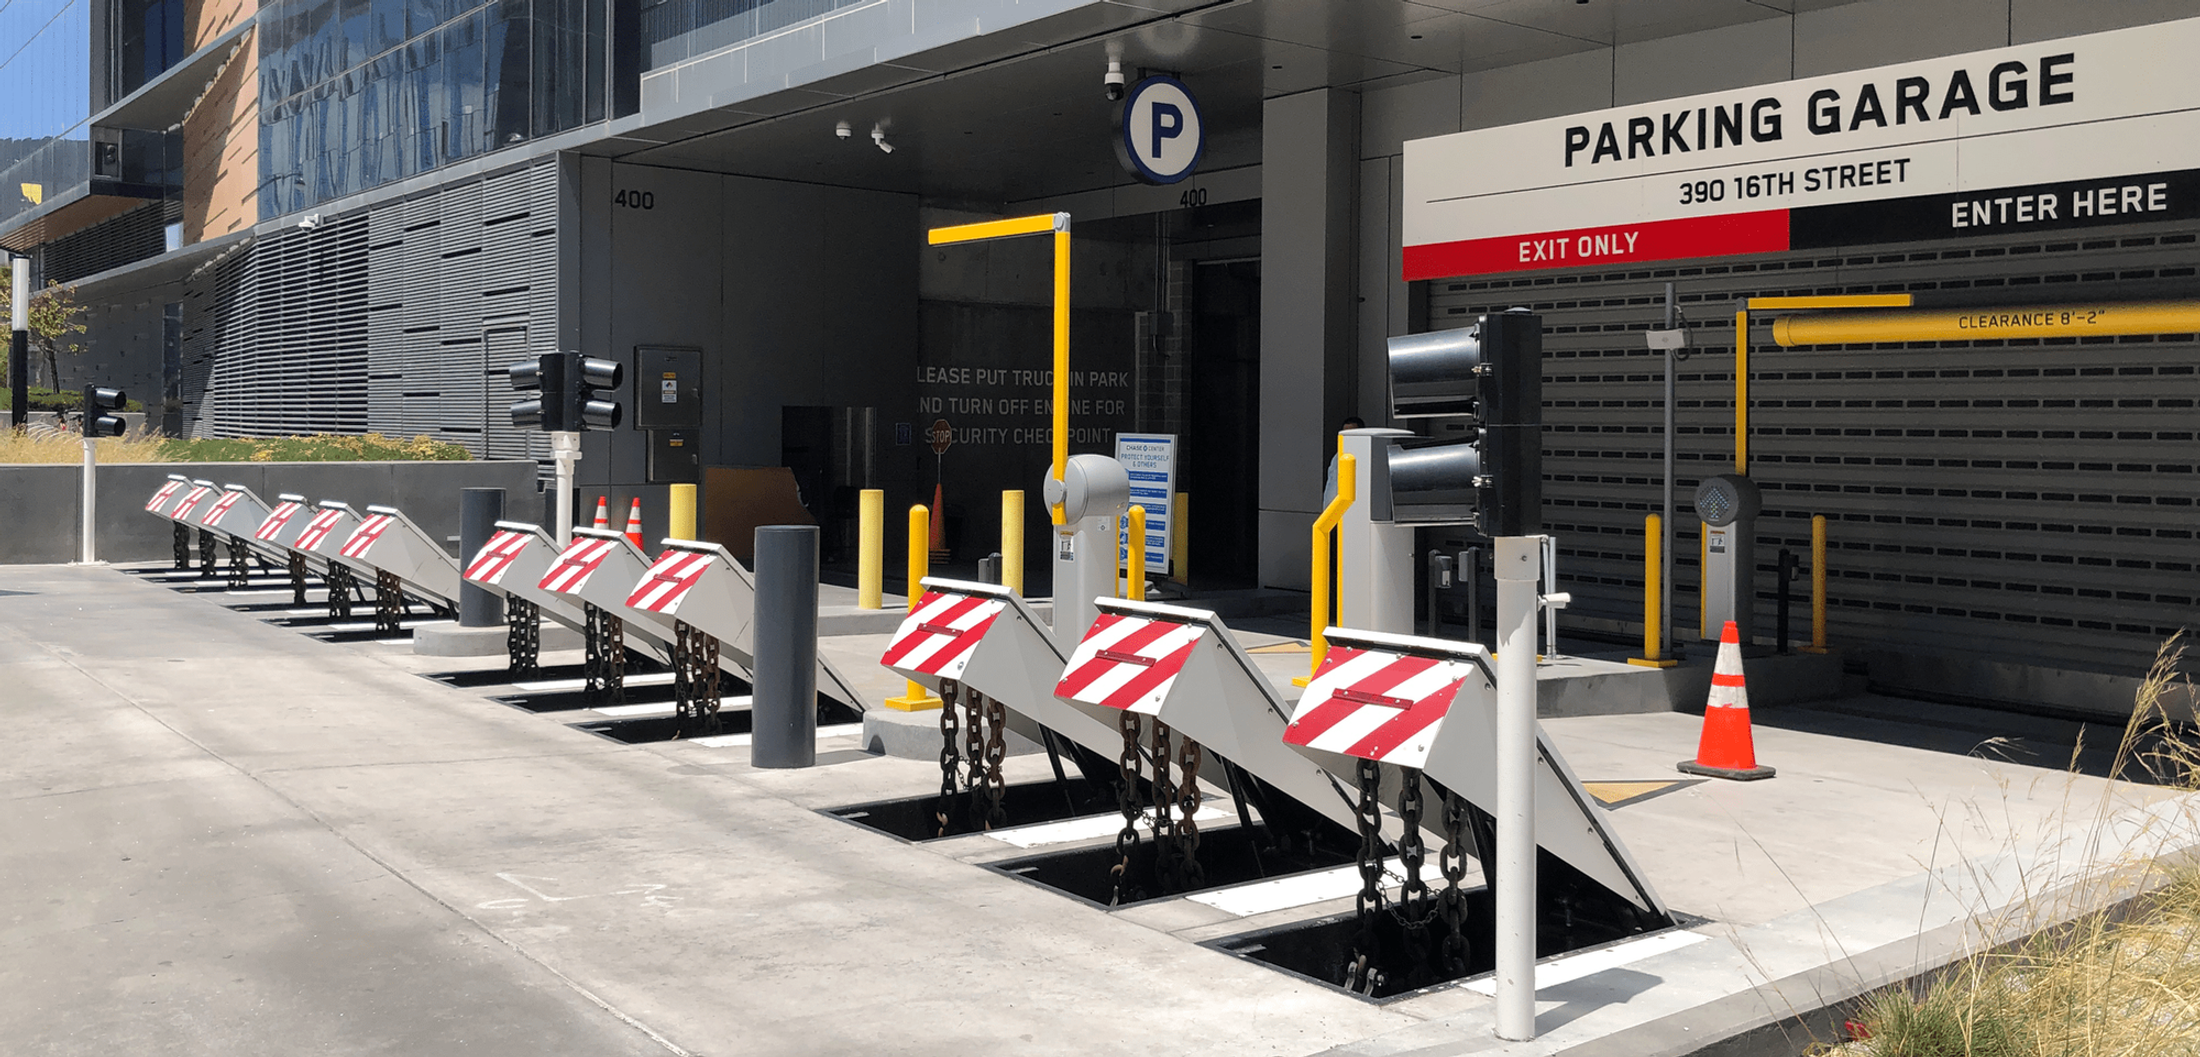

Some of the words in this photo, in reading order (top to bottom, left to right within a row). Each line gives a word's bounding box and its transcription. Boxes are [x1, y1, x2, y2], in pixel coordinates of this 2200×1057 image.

[1565, 97, 1783, 168] PARKING
[1808, 52, 2075, 135] GARAGE
[1152, 102, 1183, 158] P
[1679, 179, 1725, 205] 390
[1734, 171, 1794, 200] 16TH
[1804, 158, 1911, 193] STREET
[615, 190, 654, 209] 400
[1180, 188, 1207, 207] 400
[1952, 193, 2058, 228] ENTER
[2073, 182, 2167, 218] HERE
[1519, 237, 1570, 262] EXIT
[1578, 232, 1639, 258] ONLY
[1959, 312, 2054, 329] CLEARANCE
[917, 366, 971, 385] LEASE
[976, 368, 1008, 386] PUT
[1012, 369, 1054, 386] TRUC
[1070, 371, 1084, 387] IN
[1089, 371, 1128, 388] PARK
[917, 396, 942, 413] ND
[948, 397, 993, 415] TURN
[999, 399, 1029, 415] OFF
[1034, 399, 1090, 415] ENNE
[1096, 400, 1124, 415] FOR
[925, 428, 1008, 444] SCURITY
[1014, 427, 1111, 444] CHECPOINT
[932, 430, 950, 443] STOP
[1121, 453, 1143, 461] PROTECT
[1144, 454, 1169, 462] YOURSELF
